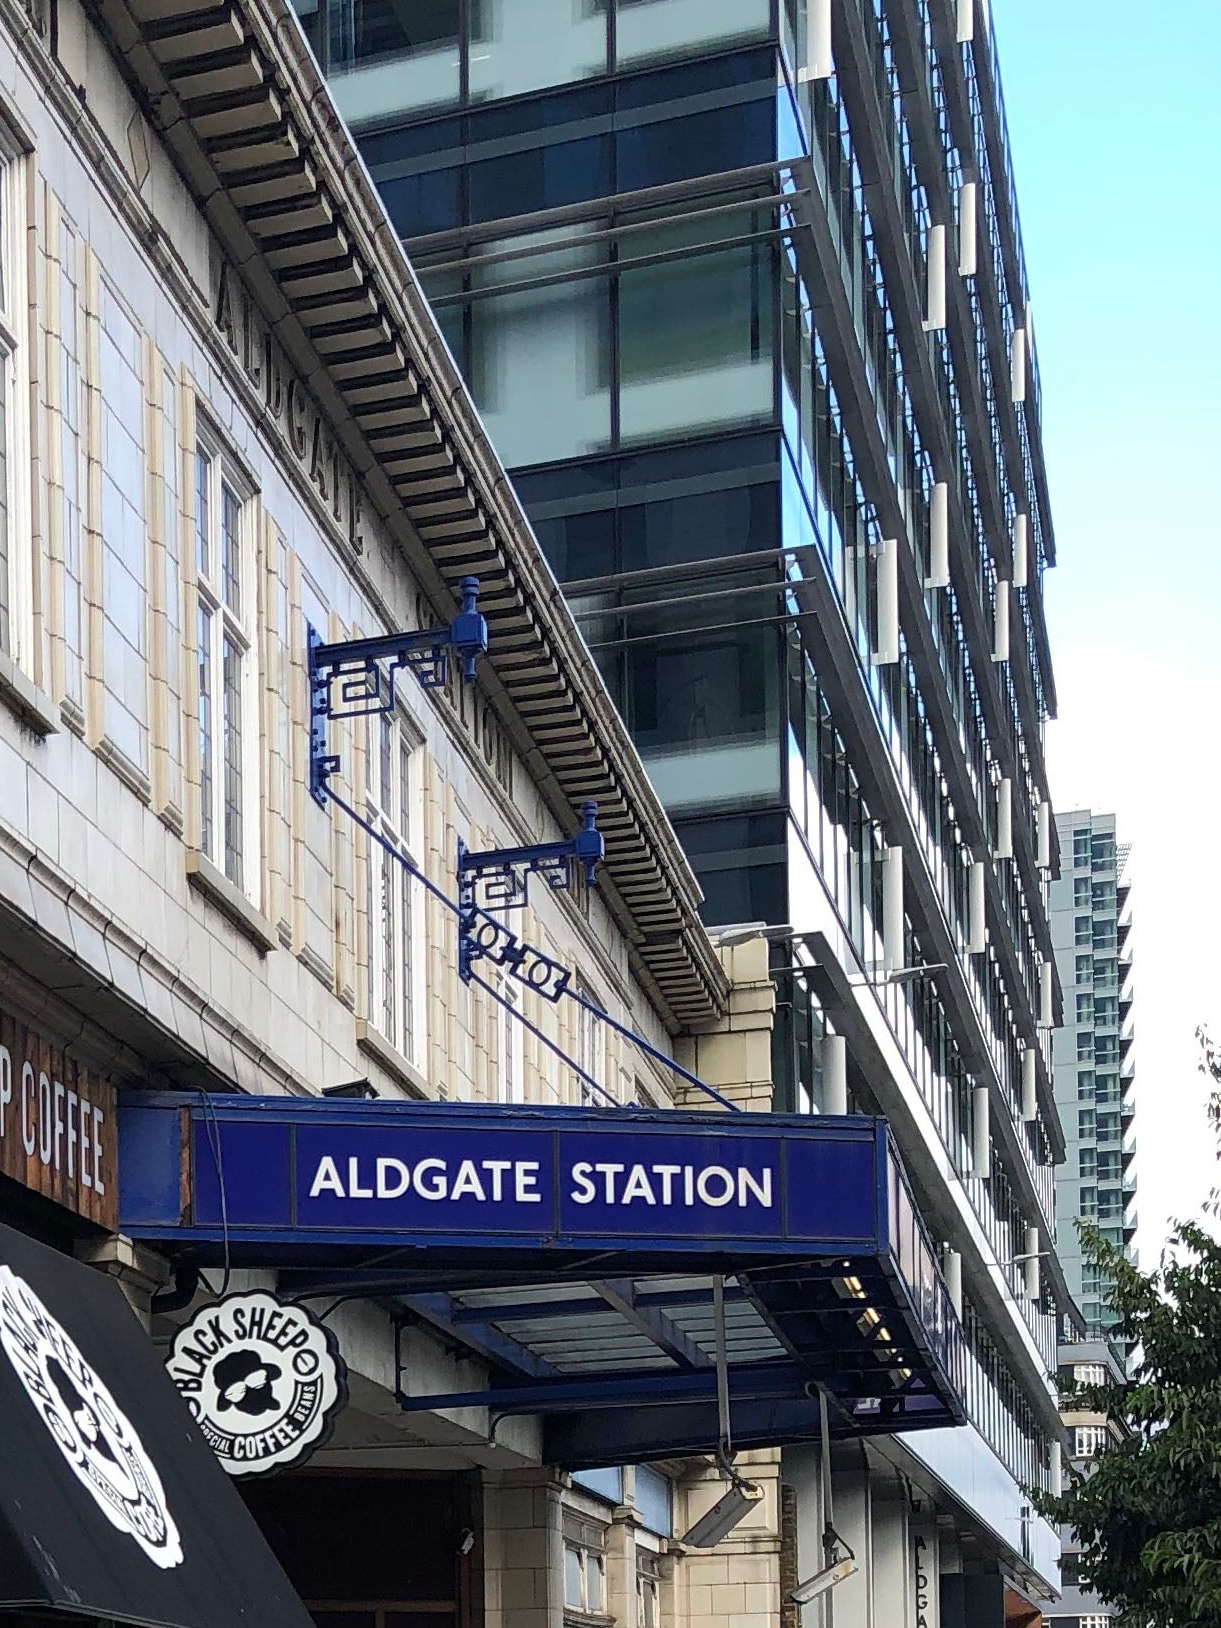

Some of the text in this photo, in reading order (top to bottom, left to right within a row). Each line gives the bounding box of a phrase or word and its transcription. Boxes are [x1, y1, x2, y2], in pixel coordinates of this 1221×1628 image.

[22, 1061, 104, 1196] COFFEE
[310, 1155, 773, 1207] ALDGATE STATION
[173, 1307, 309, 1392] BLACK SHEEP
[233, 1418, 301, 1459] COFFEE
[295, 1385, 315, 1421] BEANS
